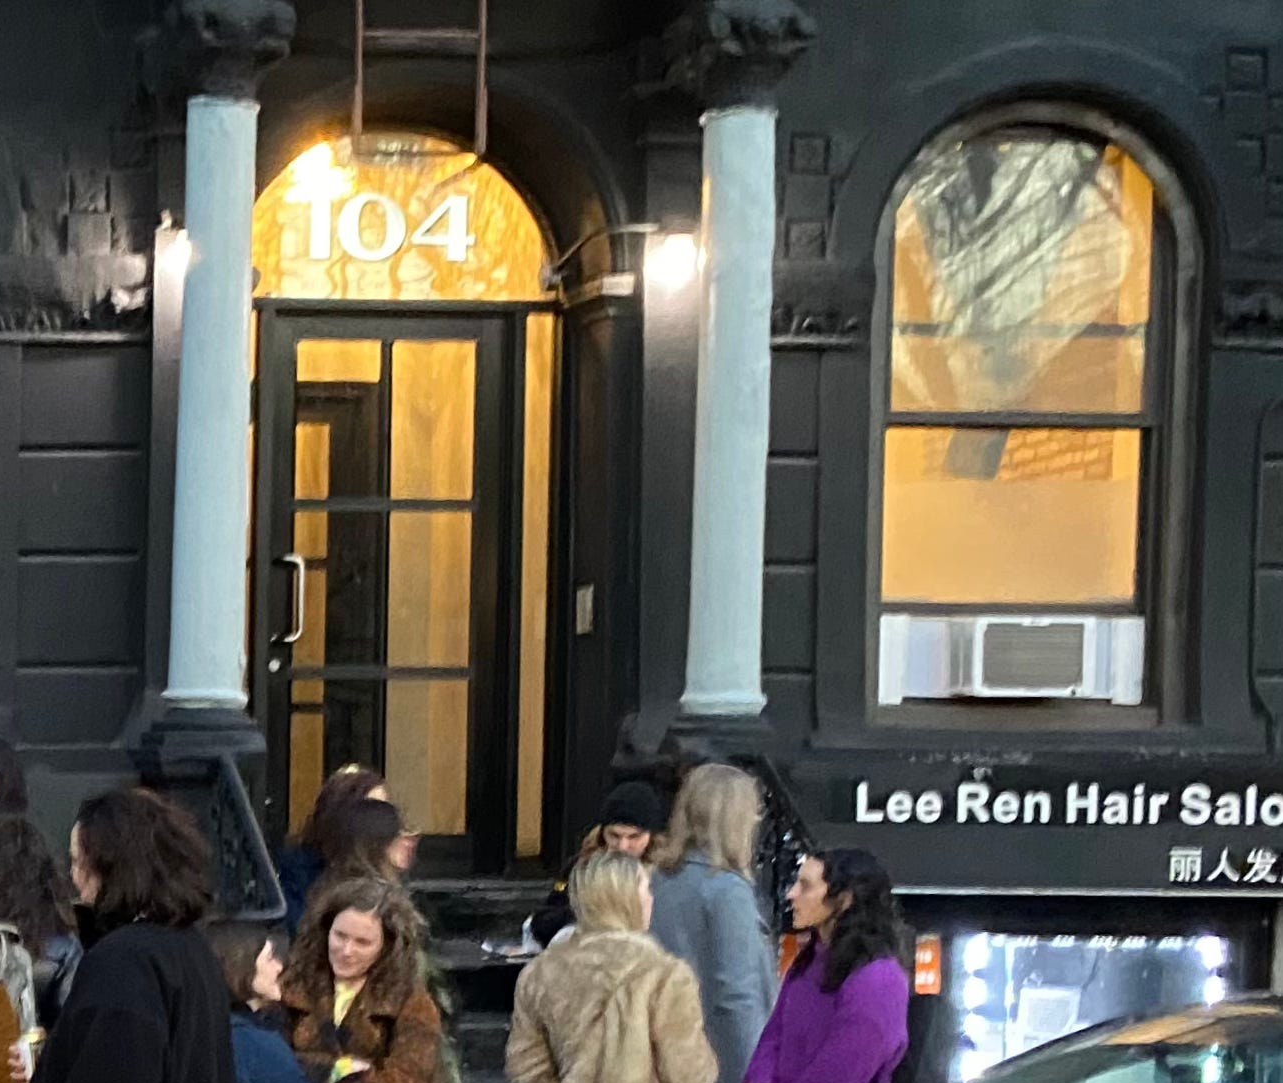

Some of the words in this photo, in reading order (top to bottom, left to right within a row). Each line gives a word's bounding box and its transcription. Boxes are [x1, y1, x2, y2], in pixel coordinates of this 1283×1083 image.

[308, 193, 477, 263] 104
[855, 780, 944, 825] Lee
[956, 781, 1053, 824] Ren
[1065, 781, 1171, 826] Hair
[1177, 782, 1283, 828] Salo
[1169, 845, 1283, 884] 丽人发
